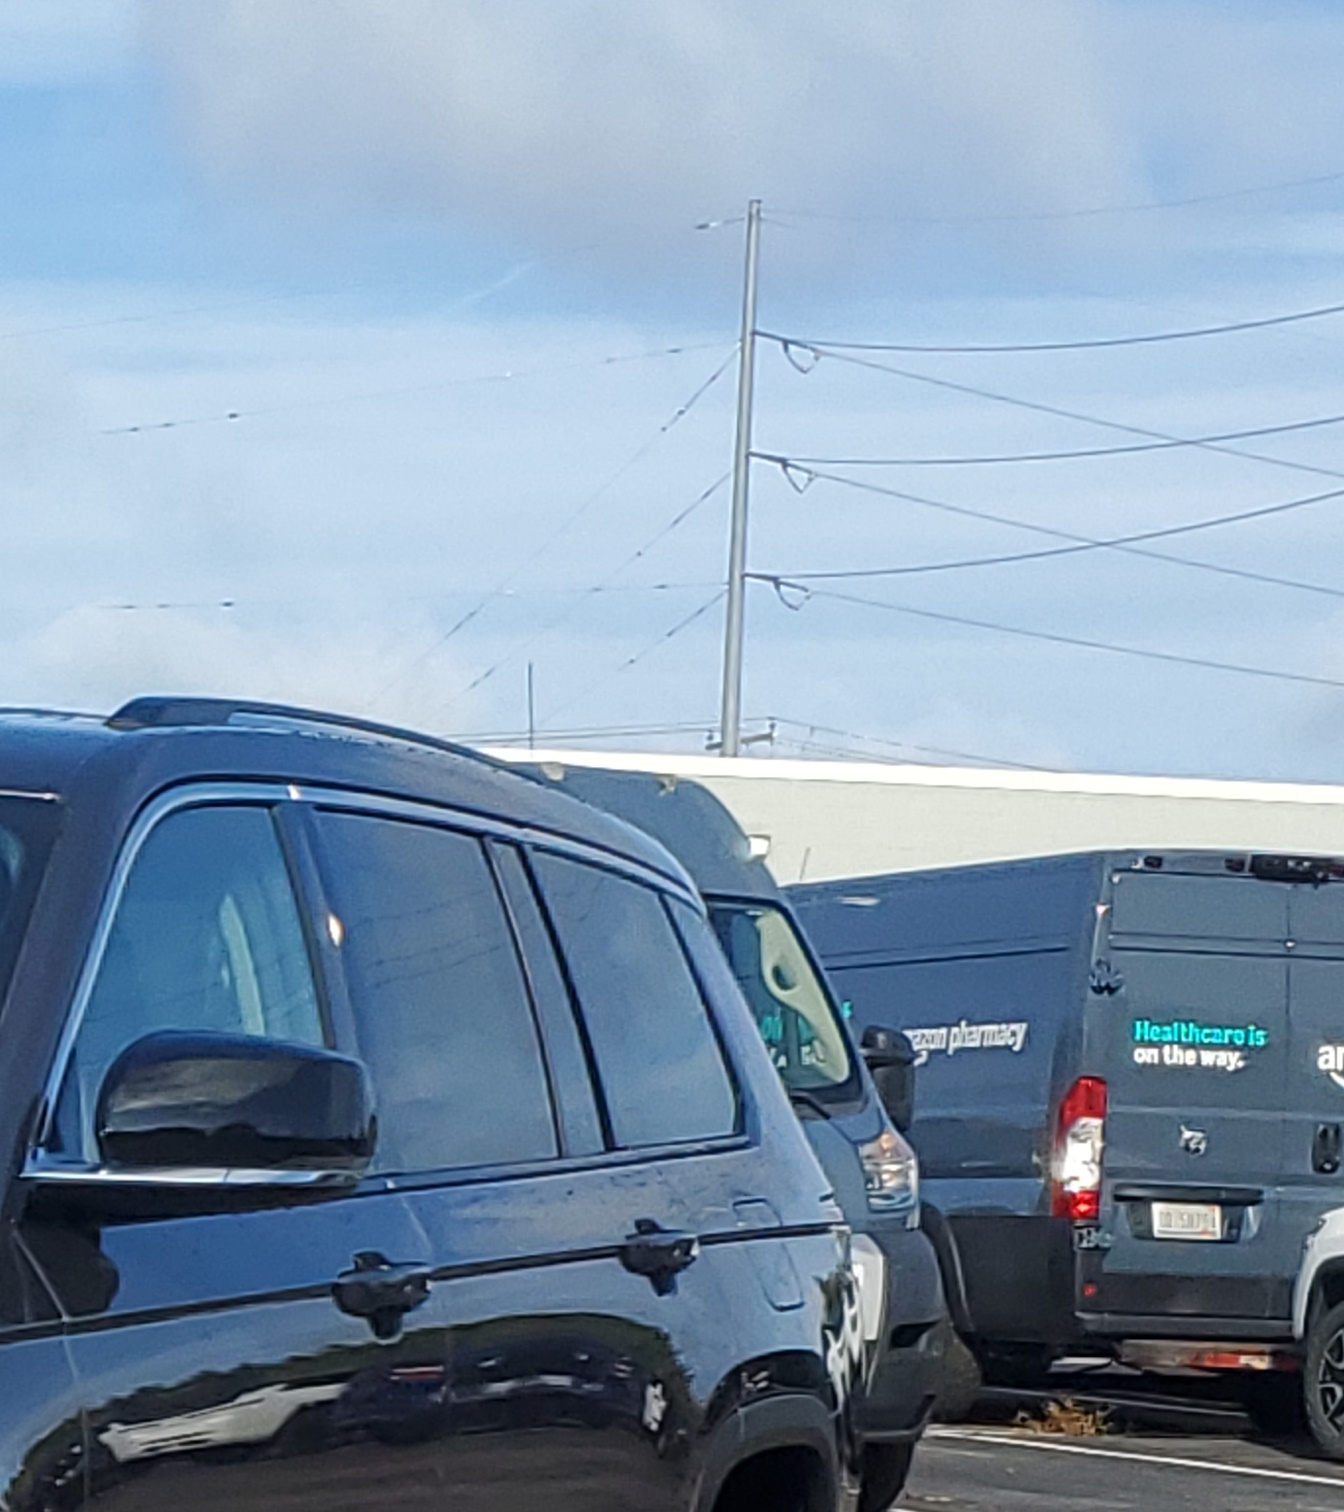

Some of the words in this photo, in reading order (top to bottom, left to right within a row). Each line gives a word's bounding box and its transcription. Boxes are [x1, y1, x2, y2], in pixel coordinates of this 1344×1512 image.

[947, 1019, 1028, 1056] pharmacy
[1133, 1020, 1246, 1046] Healthcare
[1247, 1024, 1269, 1047] is
[1133, 1046, 1159, 1065] on
[1162, 1045, 1197, 1066] the
[1200, 1050, 1246, 1072] way.
